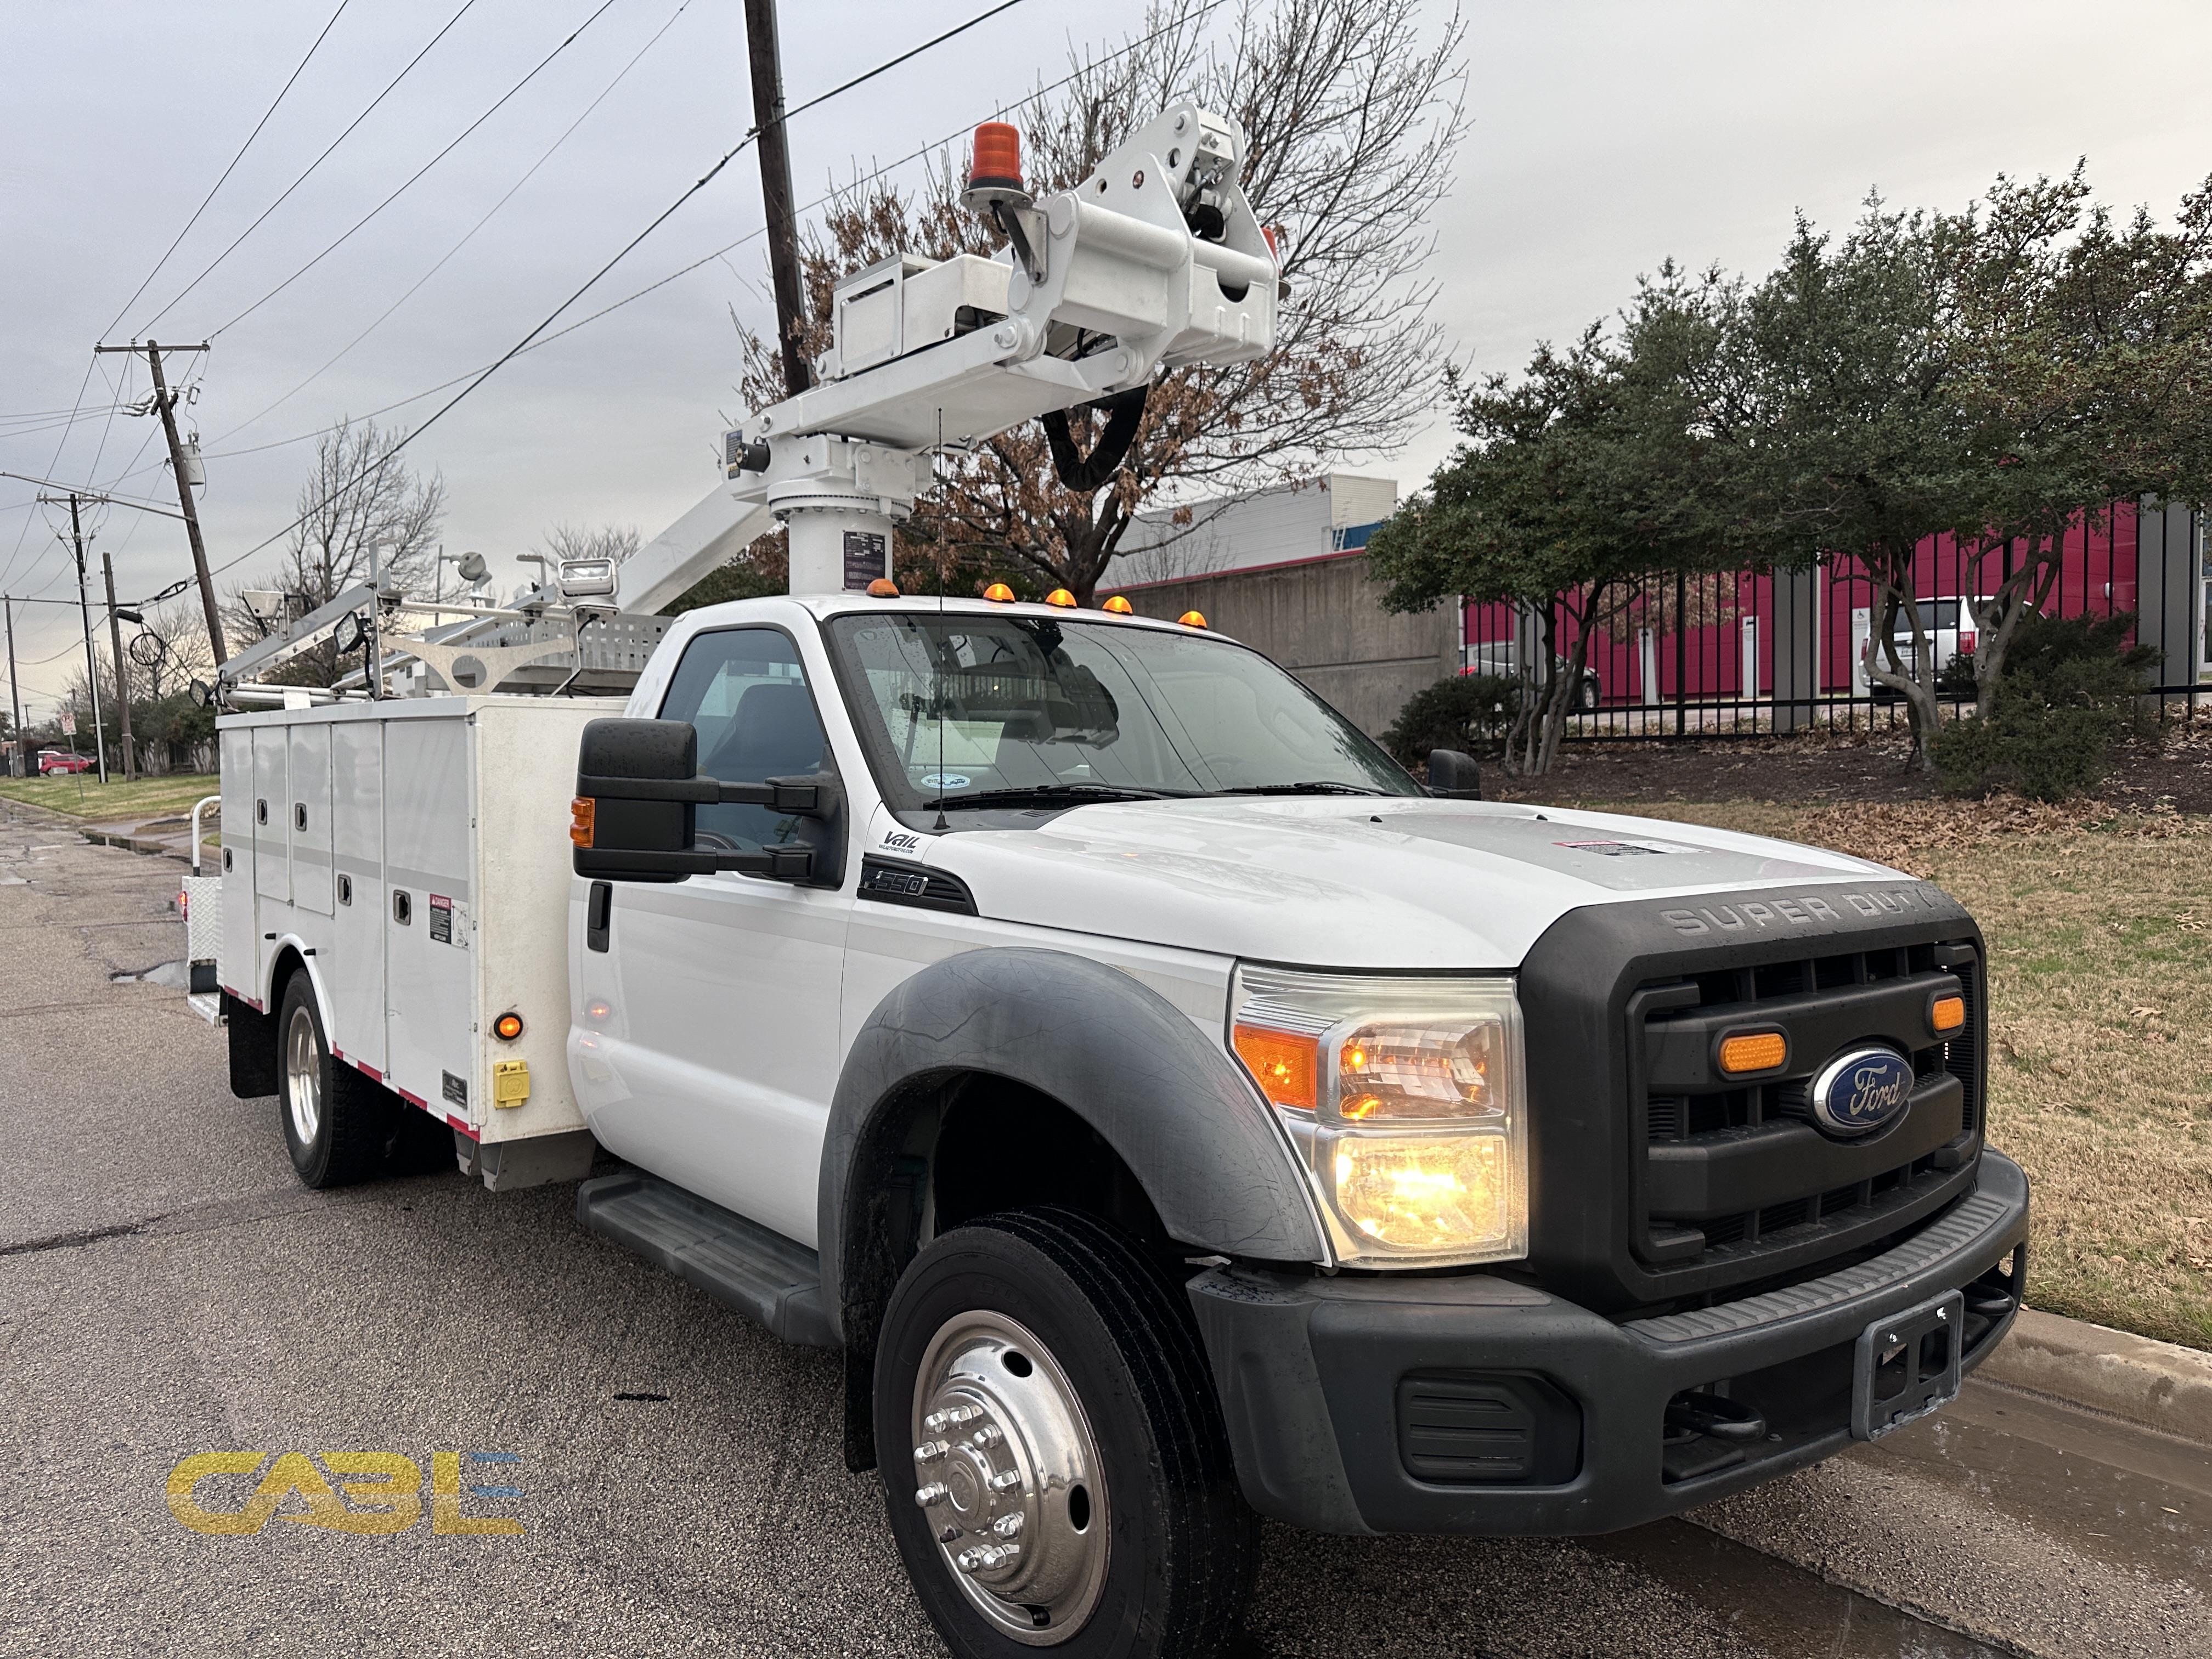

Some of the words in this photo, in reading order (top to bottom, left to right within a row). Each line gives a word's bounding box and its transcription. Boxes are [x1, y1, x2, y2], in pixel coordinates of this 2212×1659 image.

[1660, 896, 1843, 936] SUPER
[1842, 888, 1936, 917] DUTY
[1849, 1064, 1900, 1115] Ford
